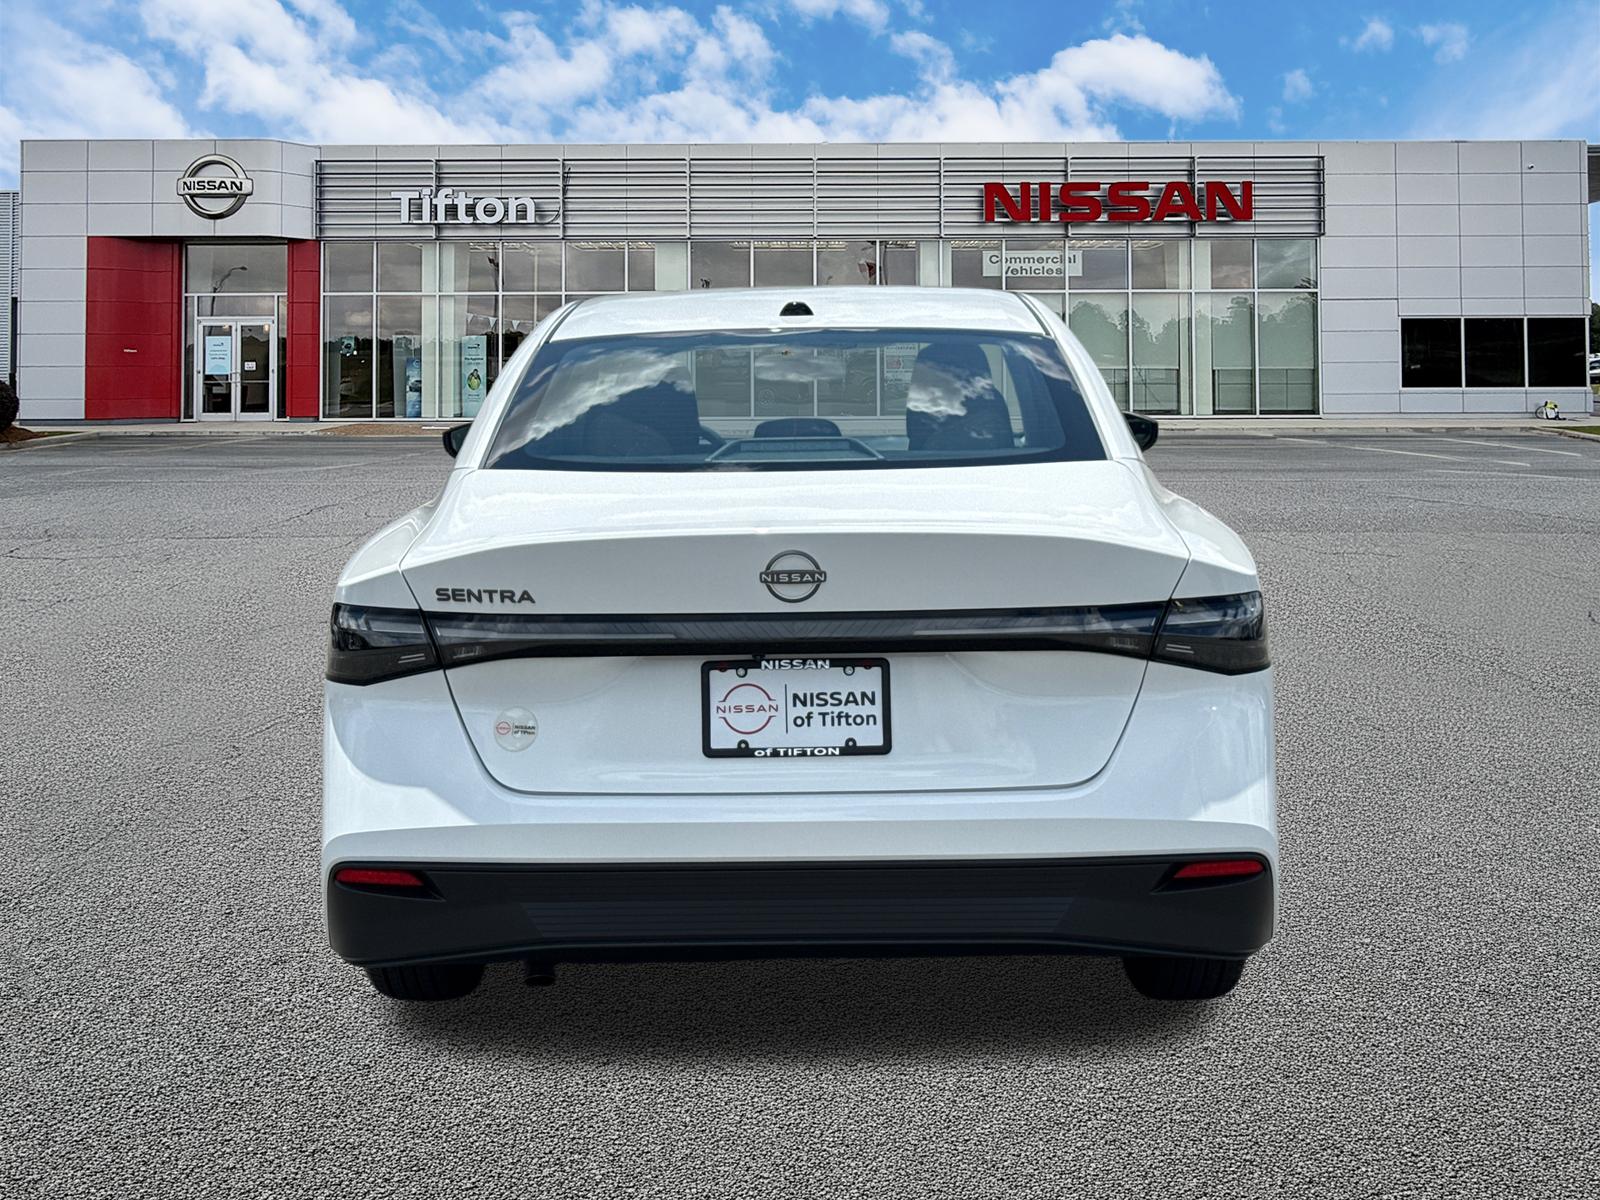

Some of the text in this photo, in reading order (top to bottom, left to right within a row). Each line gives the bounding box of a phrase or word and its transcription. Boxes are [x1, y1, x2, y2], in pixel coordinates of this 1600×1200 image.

[182, 180, 243, 191] NISSAN
[391, 188, 536, 224] Tifton
[984, 181, 1253, 222] NISSAN
[761, 572, 825, 583] NISSAN
[435, 587, 536, 604] SENTRA
[760, 659, 831, 671] NISSAN
[792, 691, 876, 707] NISSAN
[716, 703, 779, 714] NISSAN
[793, 710, 878, 728] of Tifton
[754, 747, 840, 757] of TIFTON
